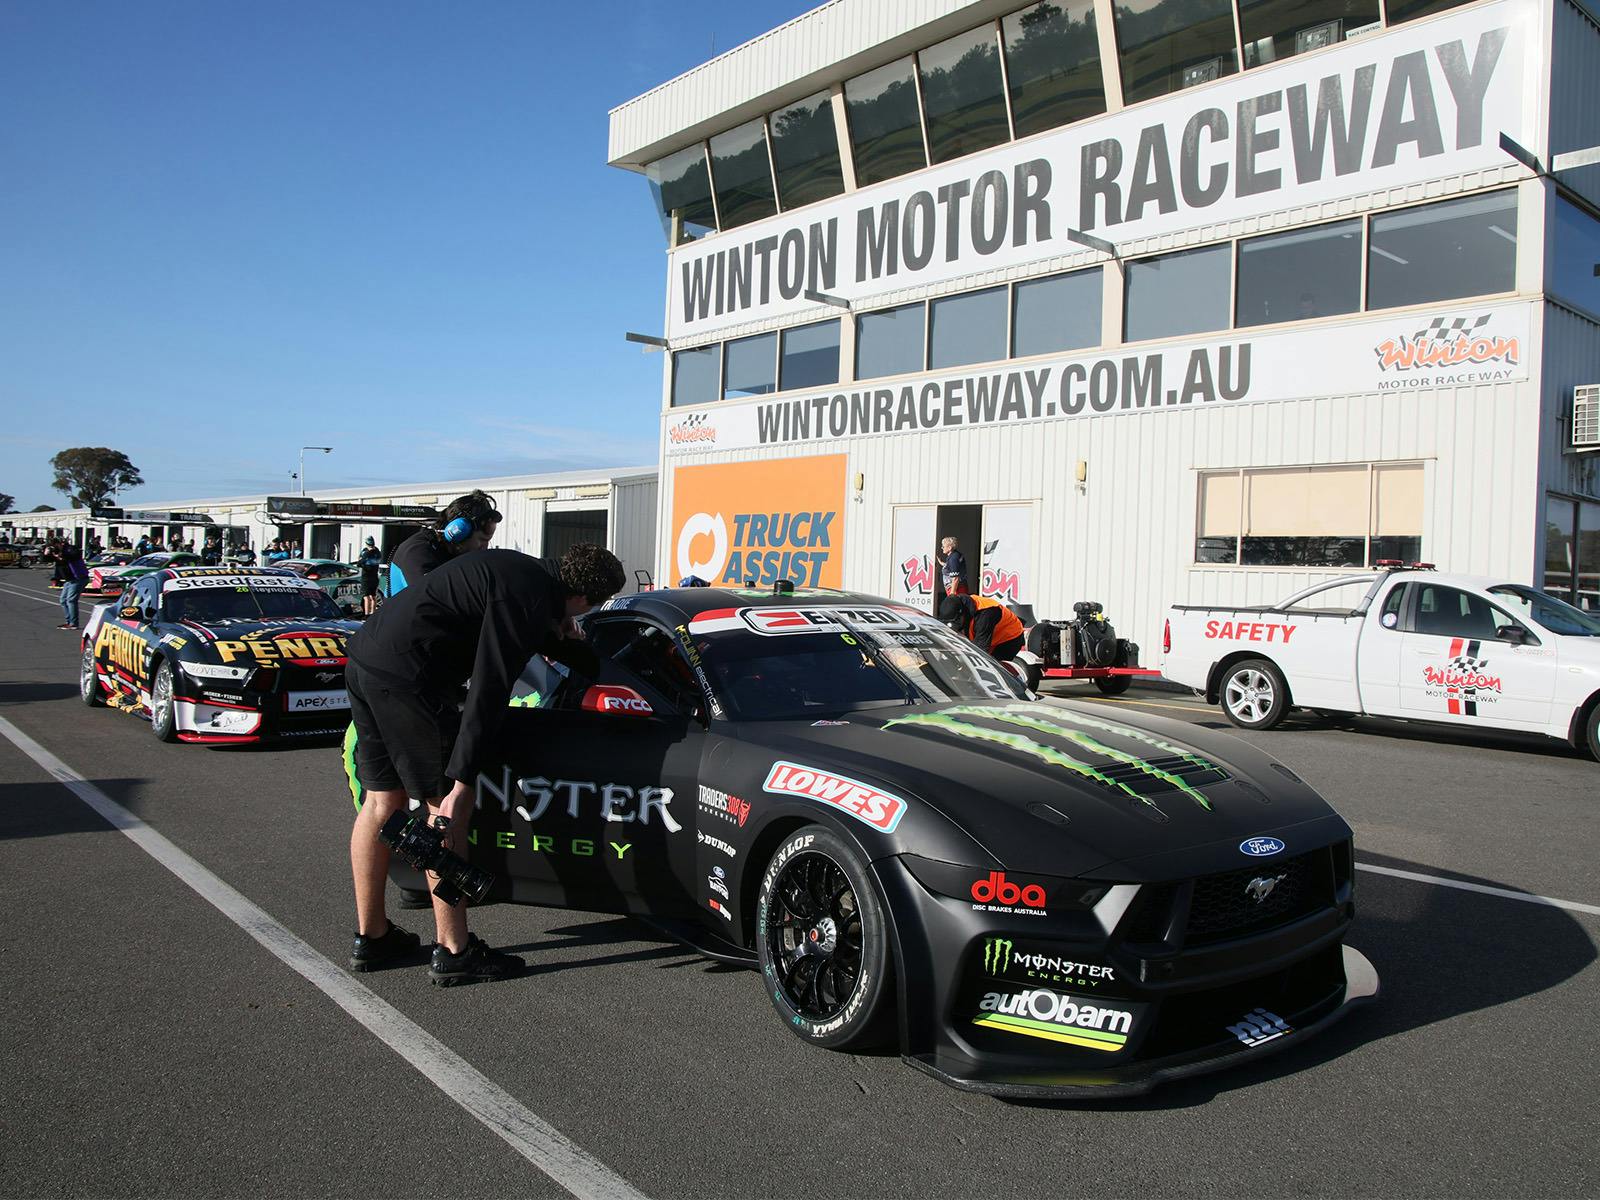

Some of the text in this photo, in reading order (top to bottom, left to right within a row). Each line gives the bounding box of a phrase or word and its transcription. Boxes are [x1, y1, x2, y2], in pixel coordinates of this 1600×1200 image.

[682, 26, 1511, 323] WINTON MOTOR RACEWAY
[1375, 333, 1519, 371] Winton
[1378, 369, 1513, 390] MOTOR RACEWAY
[757, 342, 1252, 444] WINTONRACEWAY.COM.AU
[669, 423, 717, 444] Winton
[733, 510, 836, 548] TRUCK
[721, 551, 829, 588] ASSIST
[176, 577, 287, 589] Steadfast
[841, 632, 935, 646] 6 aters
[1205, 620, 1296, 644] SAFETY
[695, 666, 723, 717] electrical
[1423, 666, 1502, 693] Winton
[295, 696, 330, 708] APEX
[603, 696, 653, 712] RYCO
[1425, 690, 1498, 704] MOTOR RACEWAY
[475, 764, 683, 834] NSTER
[771, 766, 888, 823] LOWES
[467, 828, 633, 860] ERGY
[703, 834, 737, 858] DUNLOP
[1242, 838, 1282, 855] Ford
[763, 835, 815, 893] DUNLOP
[971, 871, 1046, 908] dba
[988, 905, 1013, 913] BRAKES
[1013, 908, 1047, 916] AUSTRALIA
[1027, 970, 1099, 987] ENERGY
